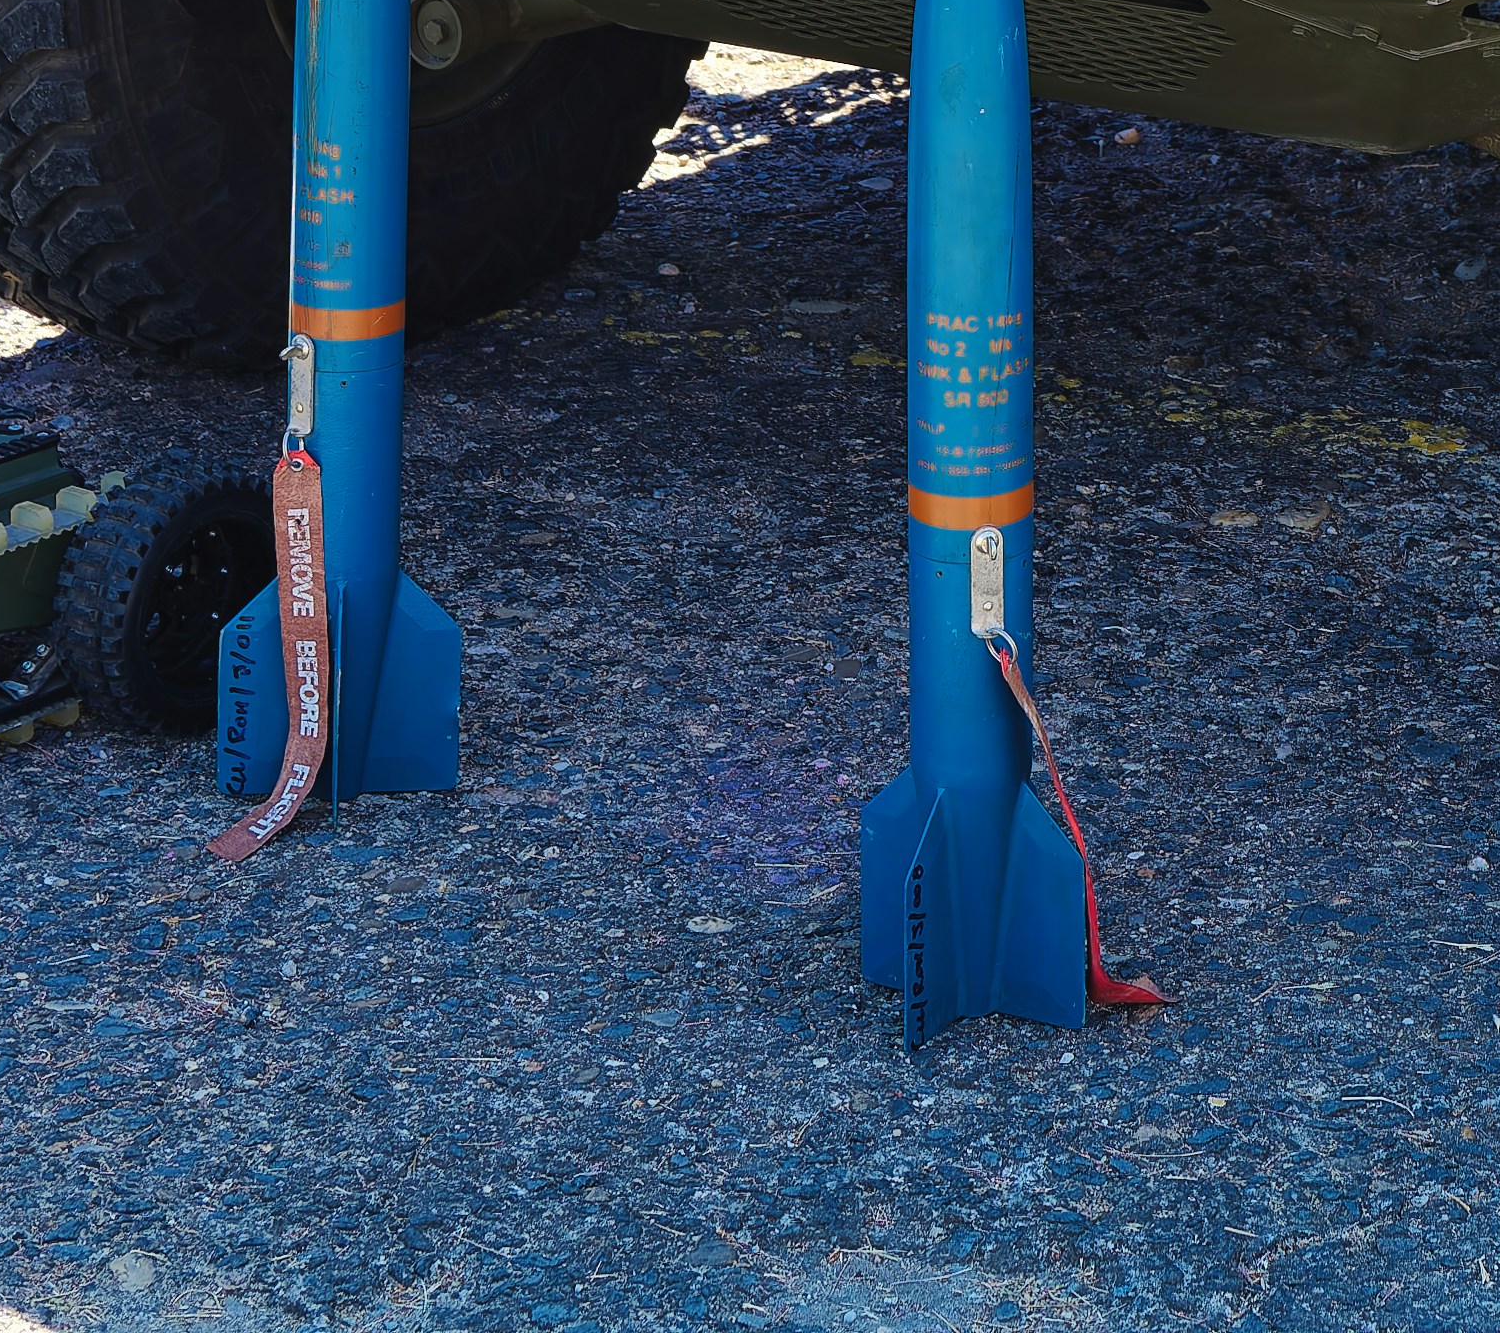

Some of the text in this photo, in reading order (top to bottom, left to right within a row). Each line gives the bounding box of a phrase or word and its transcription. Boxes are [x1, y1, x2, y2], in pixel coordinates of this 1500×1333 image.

[927, 313, 978, 332] PRAC
[955, 341, 966, 357] 2
[958, 367, 972, 383] &
[943, 389, 1009, 408] SR 800
[248, 507, 318, 840] REMOVE BEFORE FLIGHT
